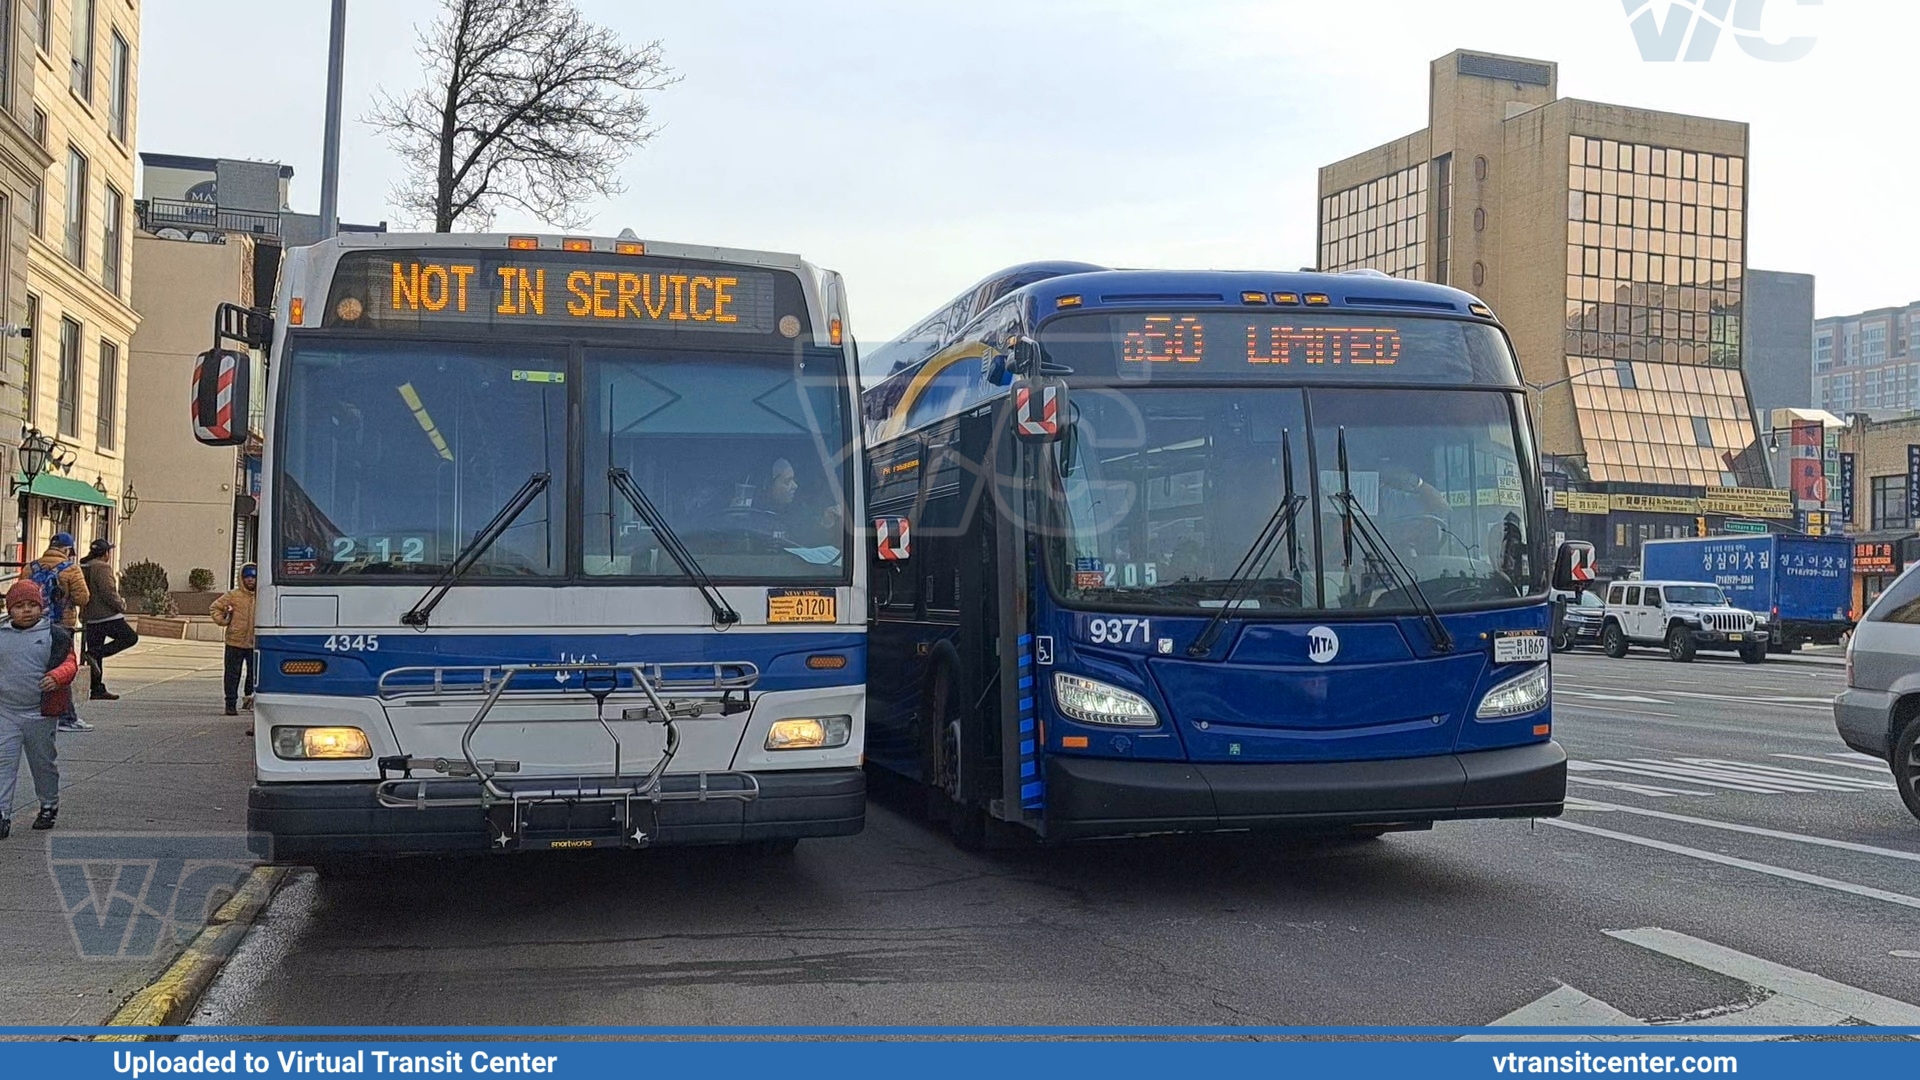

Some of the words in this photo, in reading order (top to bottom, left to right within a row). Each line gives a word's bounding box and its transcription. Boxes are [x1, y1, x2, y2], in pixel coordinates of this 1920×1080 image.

[392, 262, 474, 311] NOT
[497, 267, 544, 315] IN
[566, 270, 737, 322] SERVICE
[1247, 326, 1401, 365] LIMITED
[1104, 562, 1157, 587] 205
[804, 598, 831, 616] 1201
[323, 635, 379, 652] 4345
[1090, 618, 1151, 644] 9371
[1523, 638, 1545, 655] 1869
